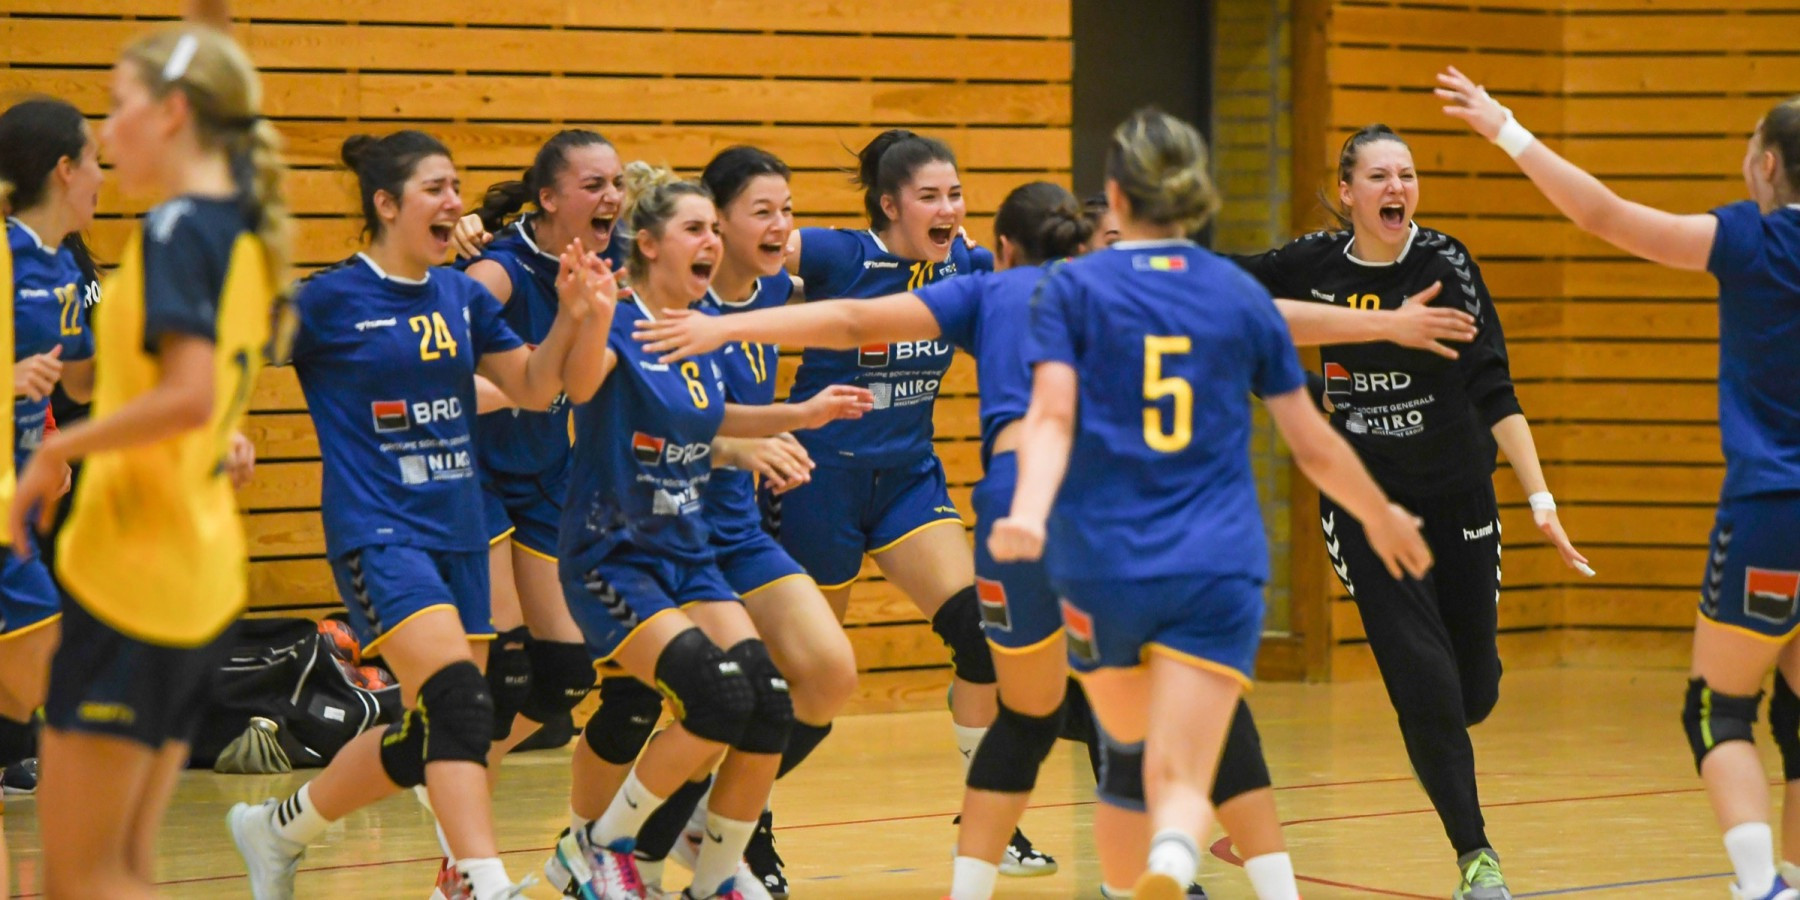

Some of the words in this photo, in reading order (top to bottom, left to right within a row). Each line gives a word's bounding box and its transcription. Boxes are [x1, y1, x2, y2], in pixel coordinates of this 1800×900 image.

[408, 311, 458, 361] 24
[896, 340, 949, 360] BRD
[680, 361, 709, 409] 6
[894, 379, 939, 398] NIRO
[1353, 371, 1411, 392] BRD
[1142, 334, 1194, 453] 5
[1389, 394, 1435, 412] GENERALE
[412, 397, 462, 425] BRD
[666, 443, 710, 466] BRD
